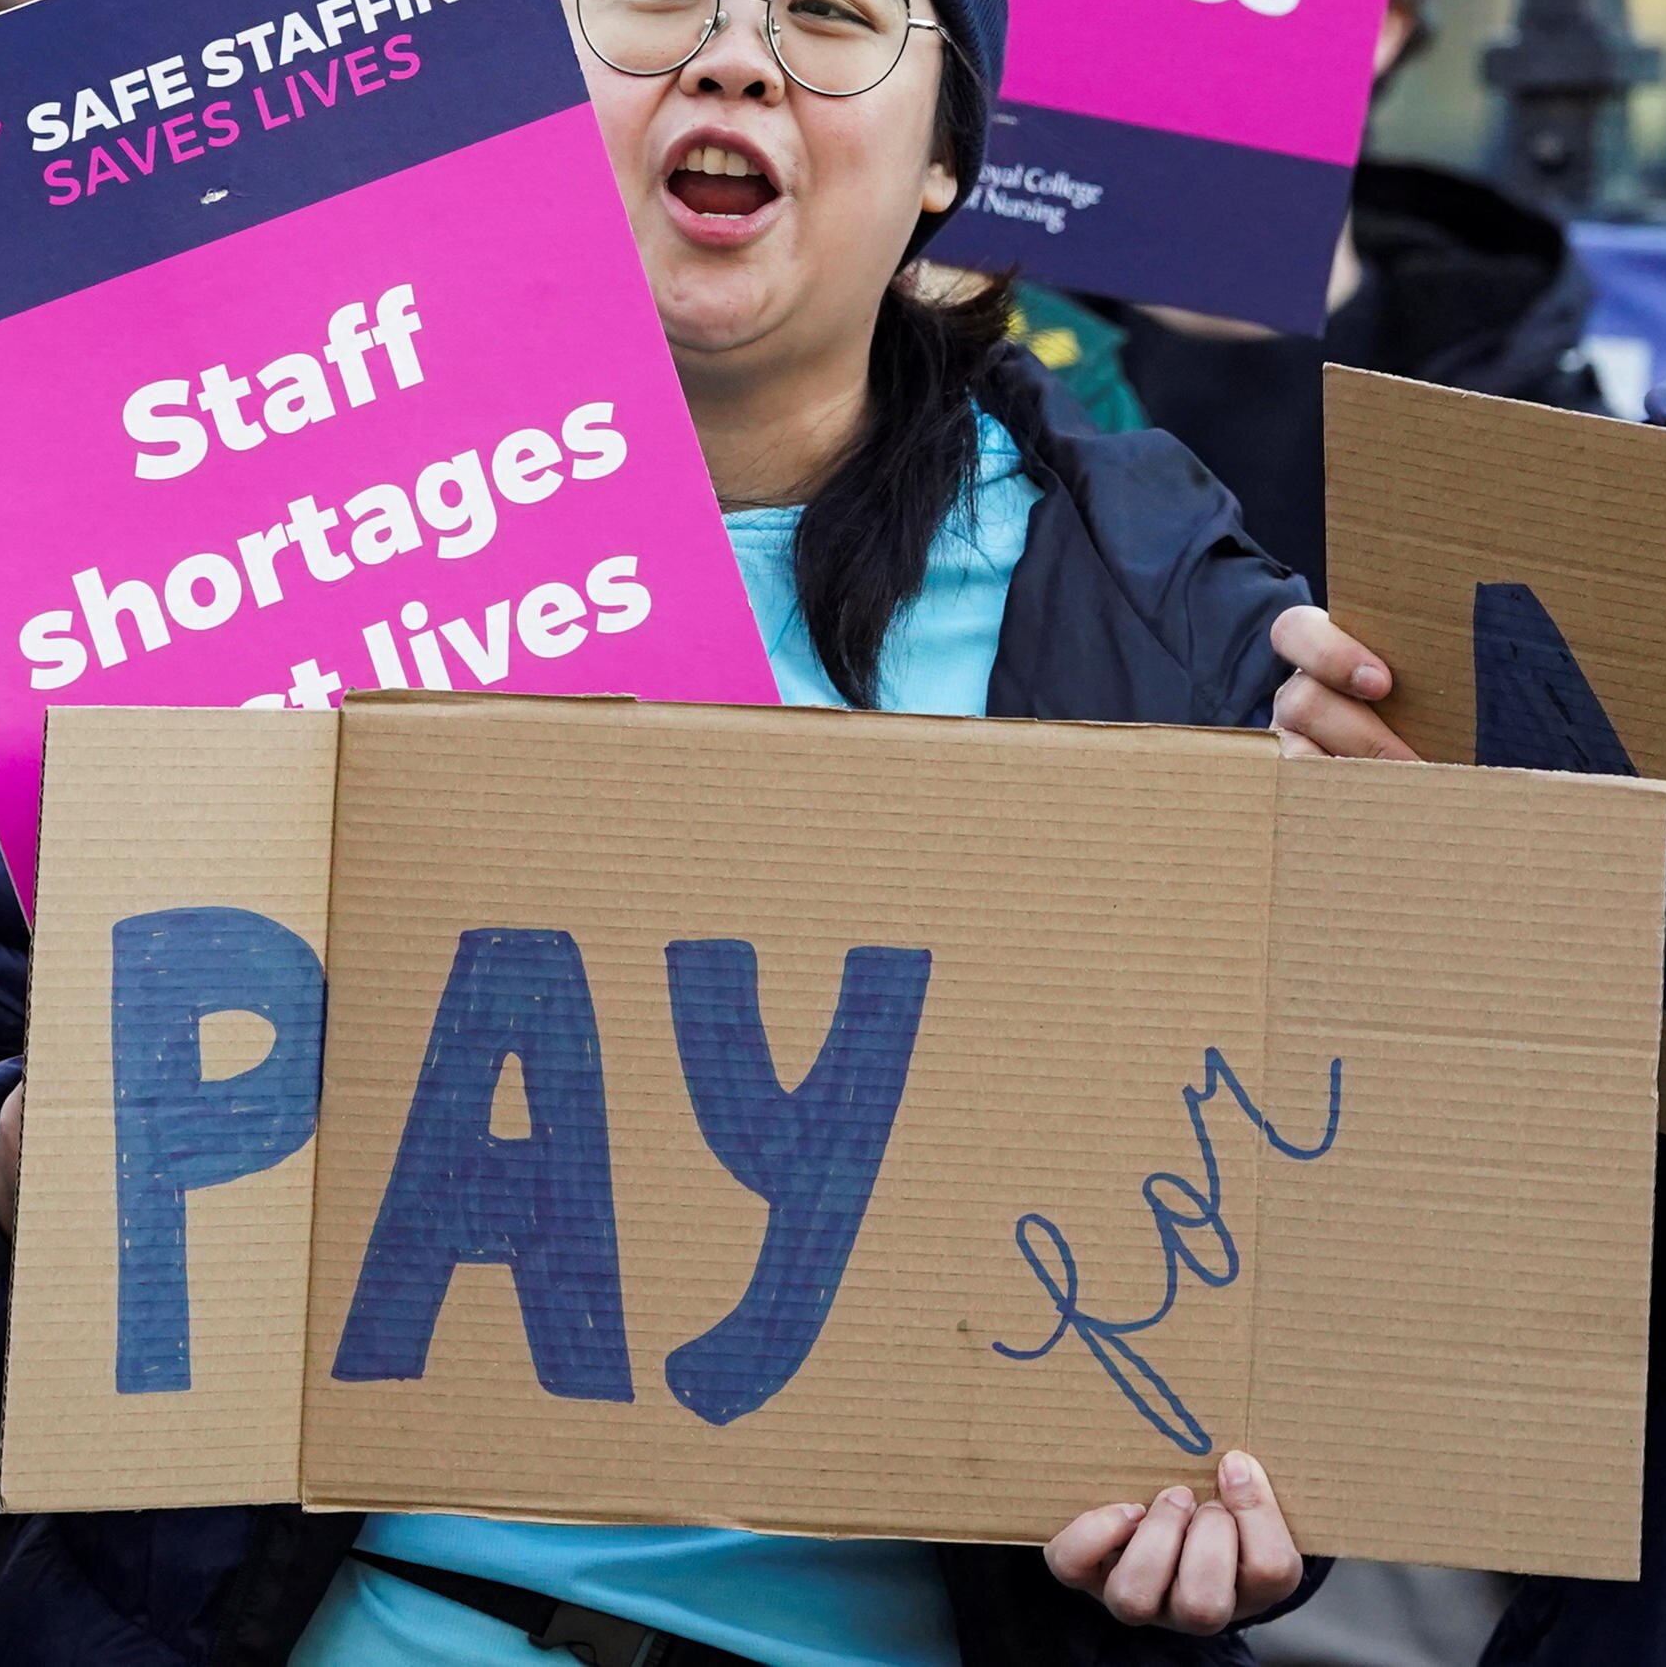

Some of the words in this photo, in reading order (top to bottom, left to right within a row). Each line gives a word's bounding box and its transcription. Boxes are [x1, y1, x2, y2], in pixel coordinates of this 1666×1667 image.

[26, 57, 196, 152] SAFE
[43, 100, 240, 206] SAVES
[252, 33, 423, 132] LIVES
[978, 163, 1025, 188] oyal
[1024, 166, 1105, 210] College
[983, 186, 1068, 234] Nursing
[121, 282, 426, 481] Staff
[17, 400, 630, 691] shortages
[361, 554, 653, 692] lives
[110, 905, 932, 1428] PAY
[992, 1046, 1342, 1456] for
